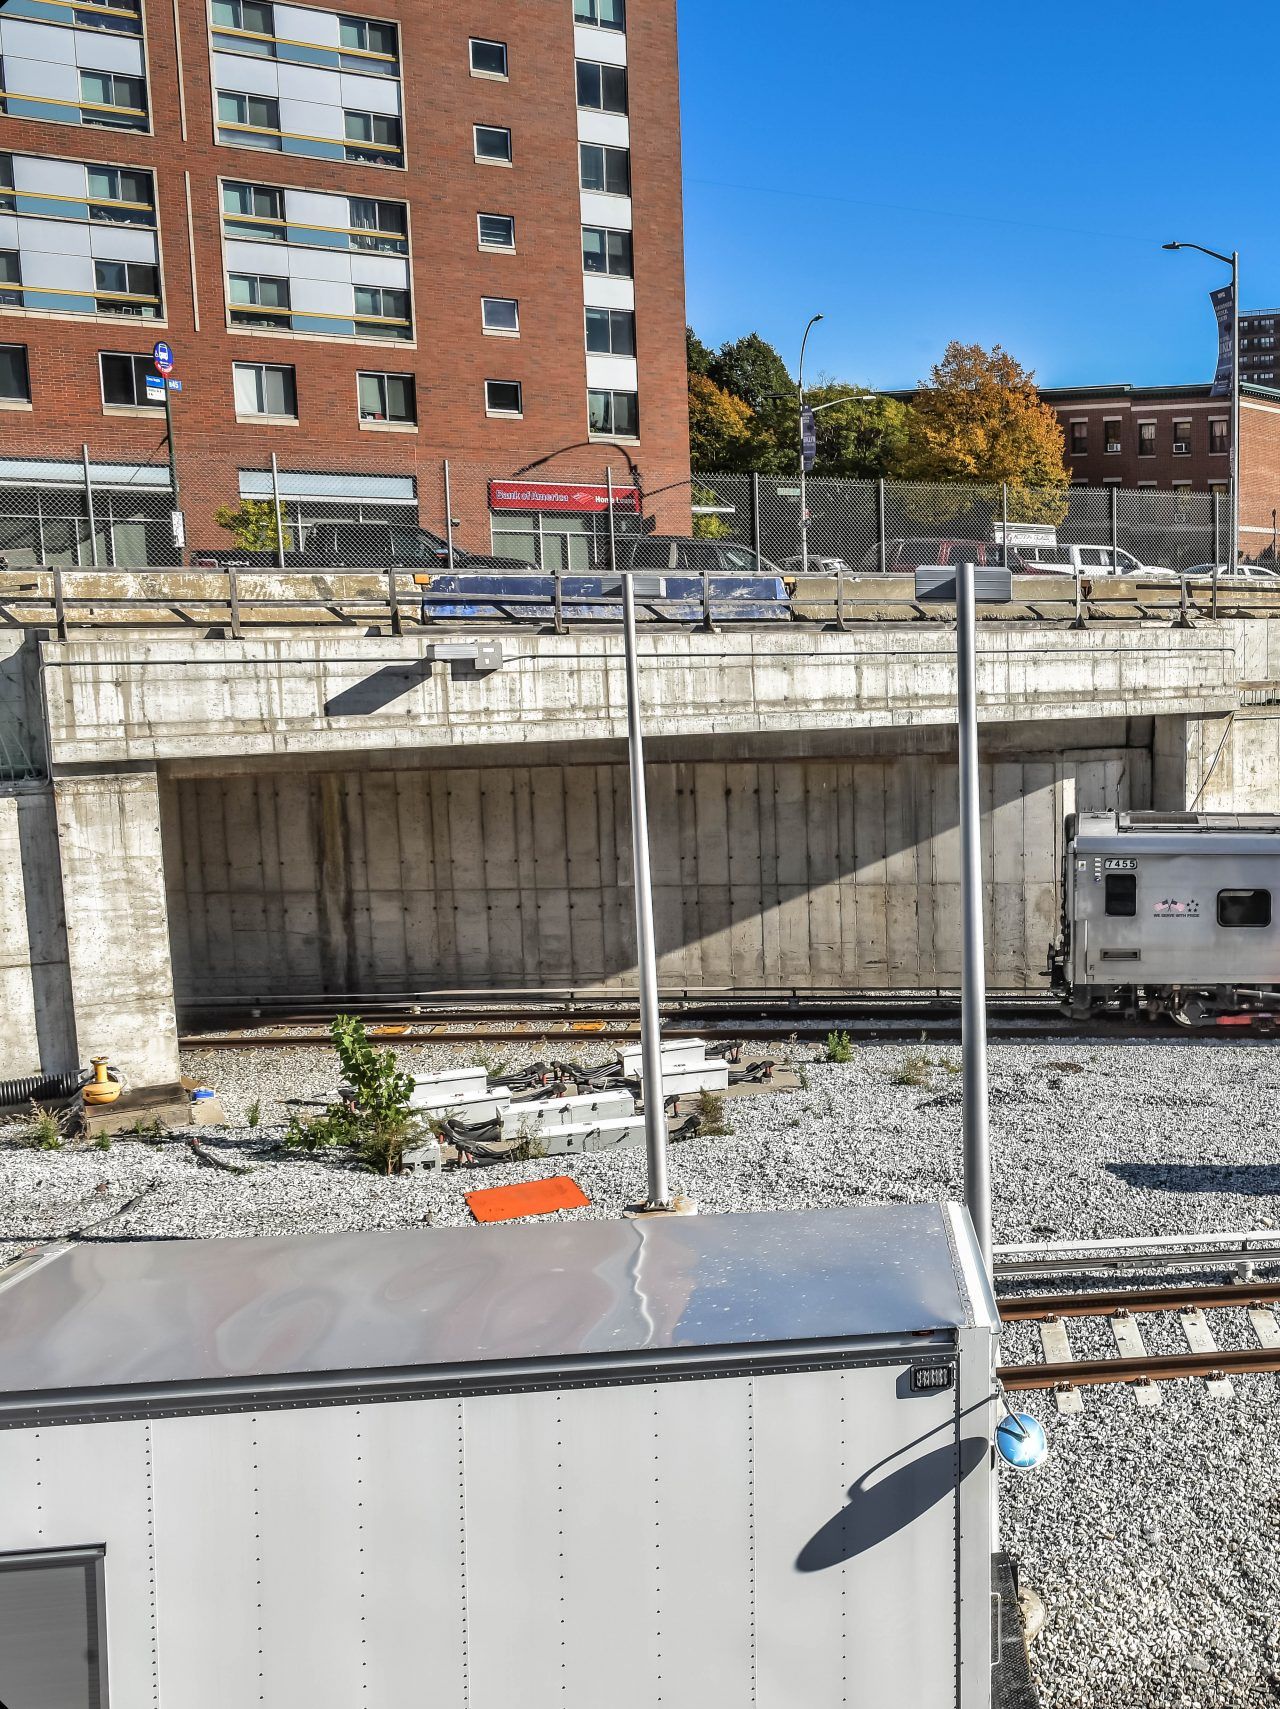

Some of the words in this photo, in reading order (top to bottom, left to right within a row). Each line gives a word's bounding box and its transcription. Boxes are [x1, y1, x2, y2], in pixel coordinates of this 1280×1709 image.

[496, 490, 520, 500] Bank
[521, 491, 531, 500] of
[532, 492, 569, 502] America
[1107, 860, 1136, 868] 7455
